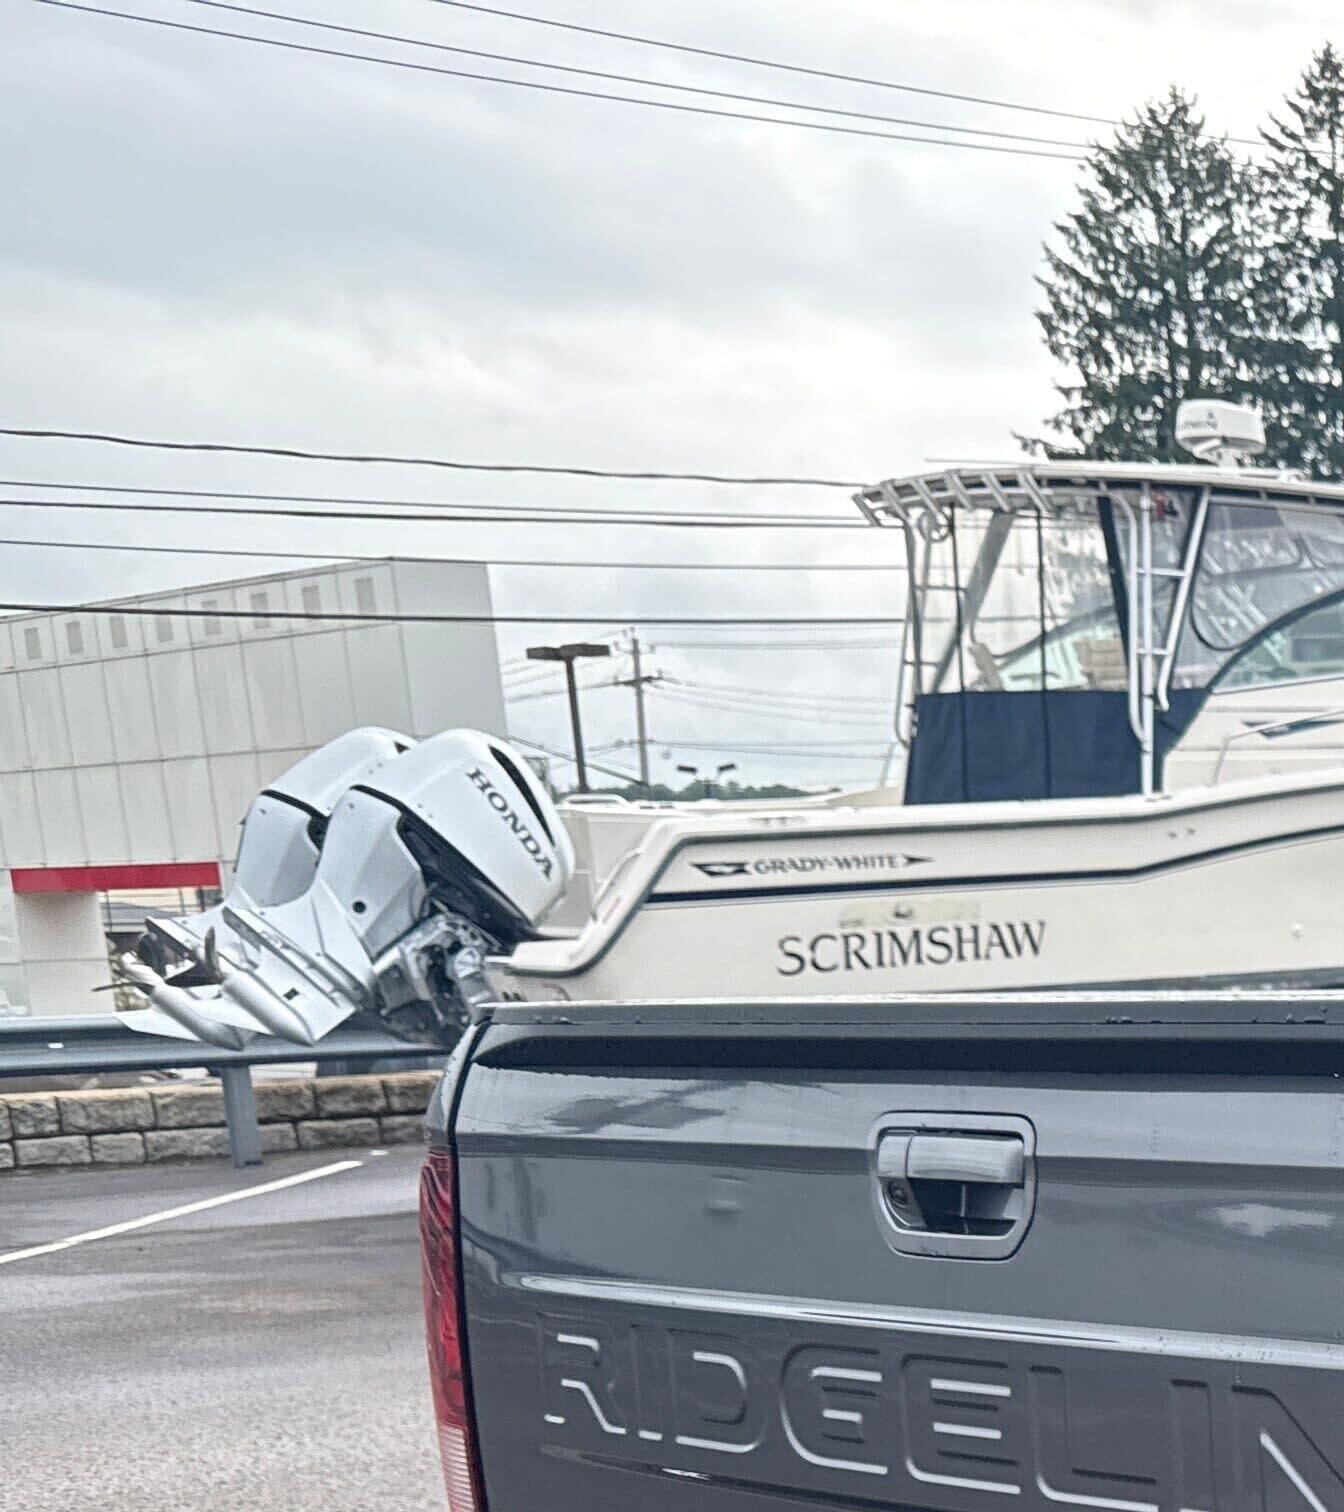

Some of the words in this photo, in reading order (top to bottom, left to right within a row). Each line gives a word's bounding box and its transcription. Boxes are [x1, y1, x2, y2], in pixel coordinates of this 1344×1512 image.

[466, 766, 552, 880] HONDA
[753, 855, 898, 875] GRADY-WHITE
[776, 919, 1046, 977] SCRIMSHAW
